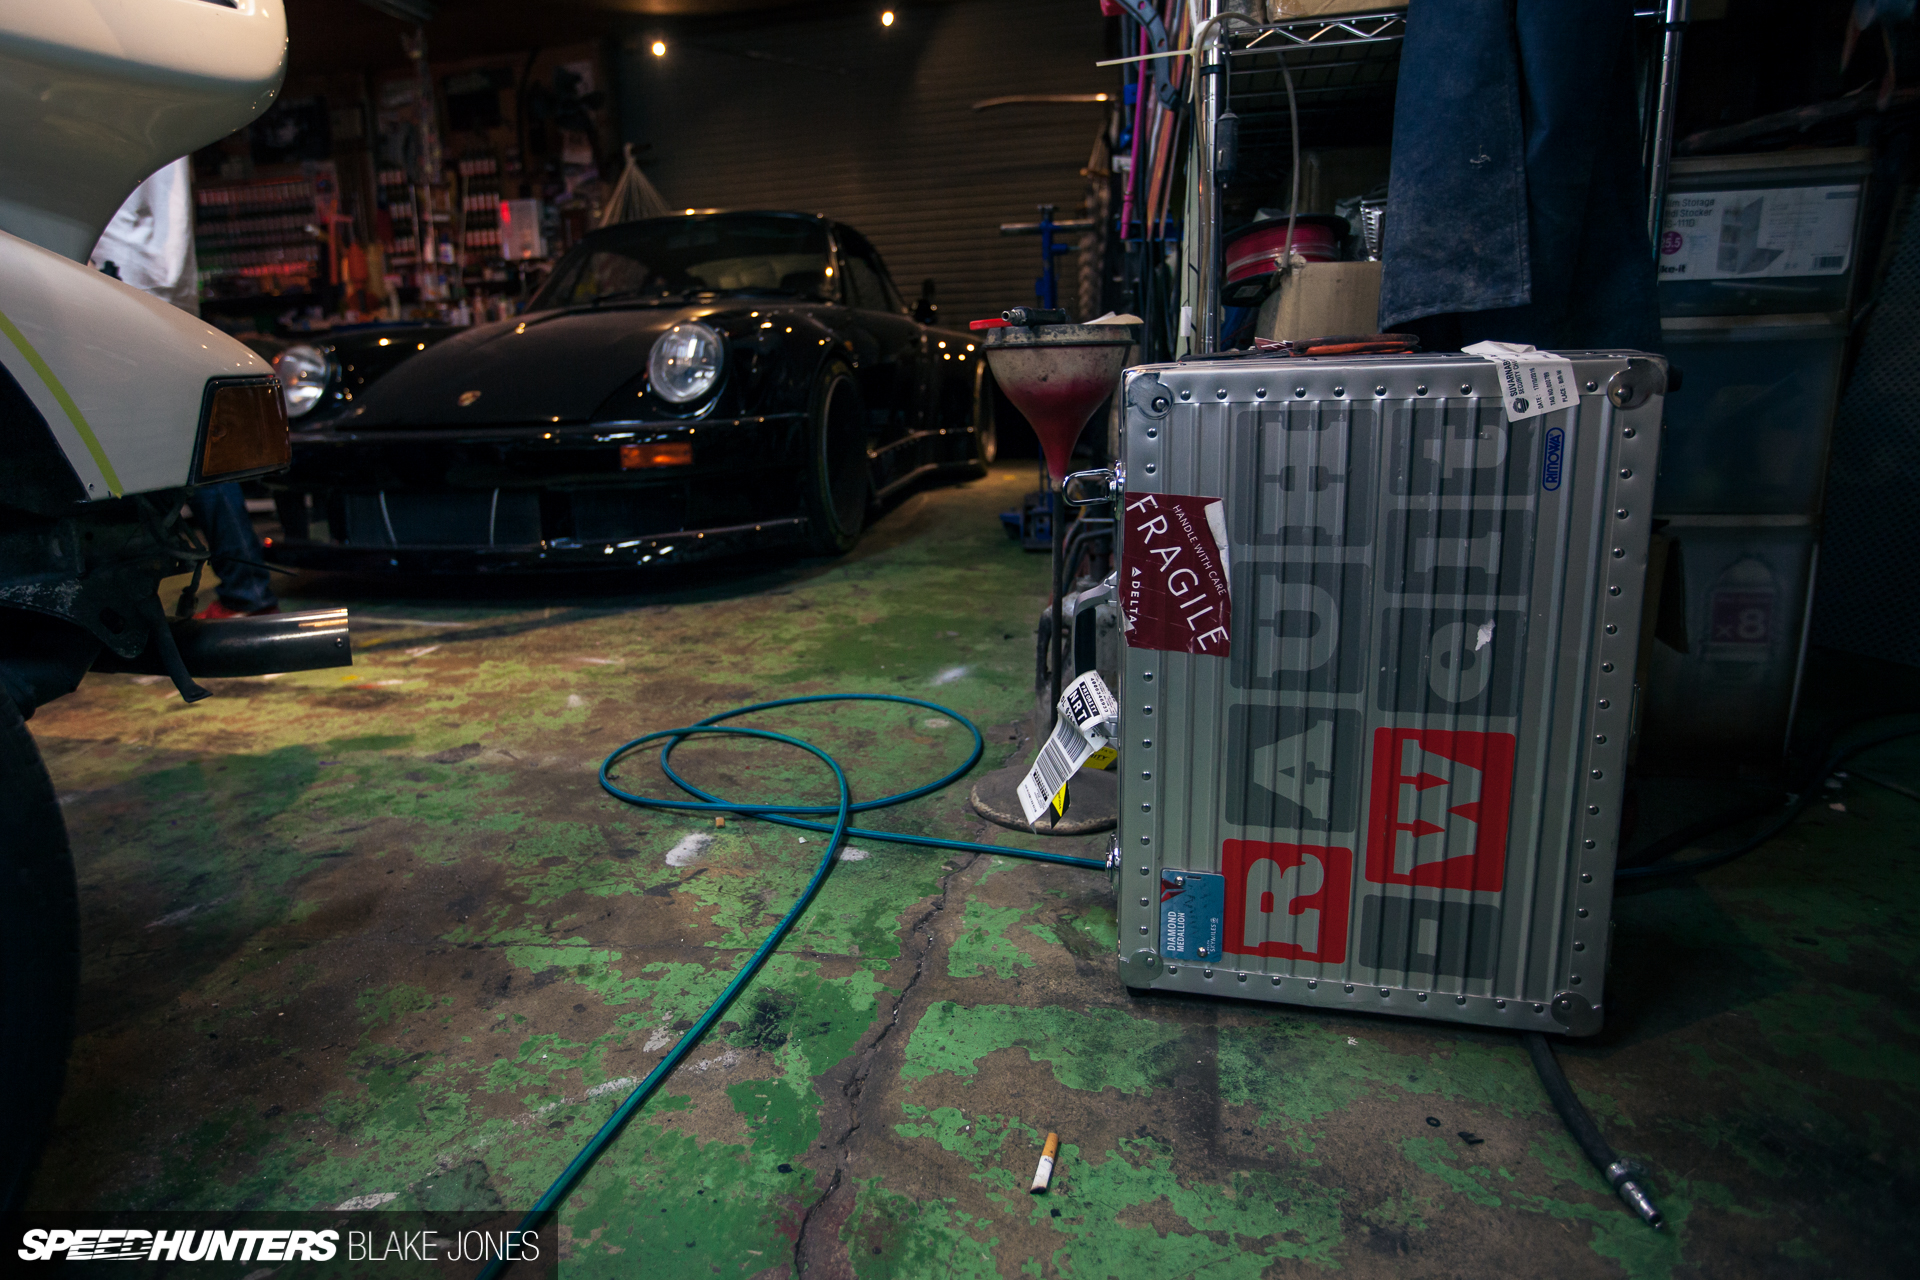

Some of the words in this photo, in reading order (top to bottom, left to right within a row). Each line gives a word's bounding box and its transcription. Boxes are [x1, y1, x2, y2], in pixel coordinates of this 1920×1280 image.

[1680, 208, 1713, 217] Stocker
[1682, 198, 1715, 208] Storage
[1514, 371, 1525, 395] SECURITY
[1546, 434, 1561, 484] RIMOWA
[1173, 504, 1198, 543] HANDLE
[1194, 543, 1213, 570] WITH
[1208, 570, 1227, 596] CARE
[1126, 495, 1229, 651] FRAGILE
[1129, 581, 1141, 623] DELTA
[1069, 689, 1088, 720] NRT
[1081, 684, 1098, 713] PRIORITY
[1167, 911, 1176, 951] DIAMOND
[1177, 912, 1185, 952] MEDALLION
